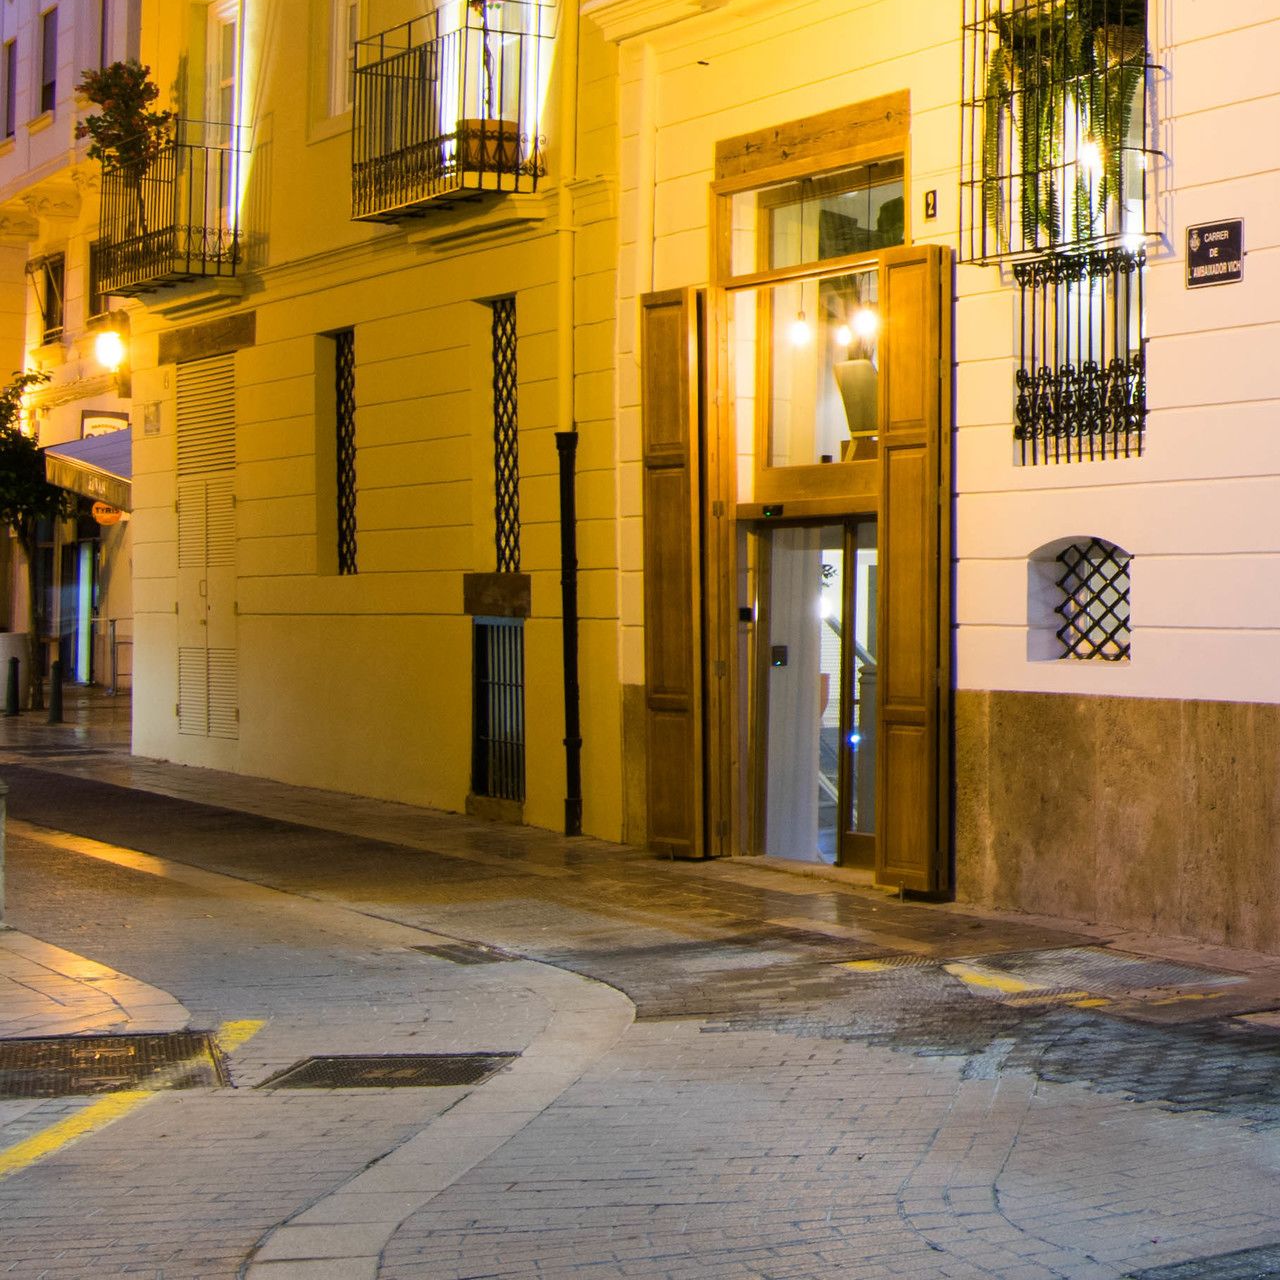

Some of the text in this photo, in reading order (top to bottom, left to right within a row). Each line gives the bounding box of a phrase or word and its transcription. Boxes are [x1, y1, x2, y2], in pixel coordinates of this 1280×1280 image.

[927, 192, 935, 216] 2
[1204, 230, 1229, 243] CARRER
[1209, 247, 1219, 257] DE
